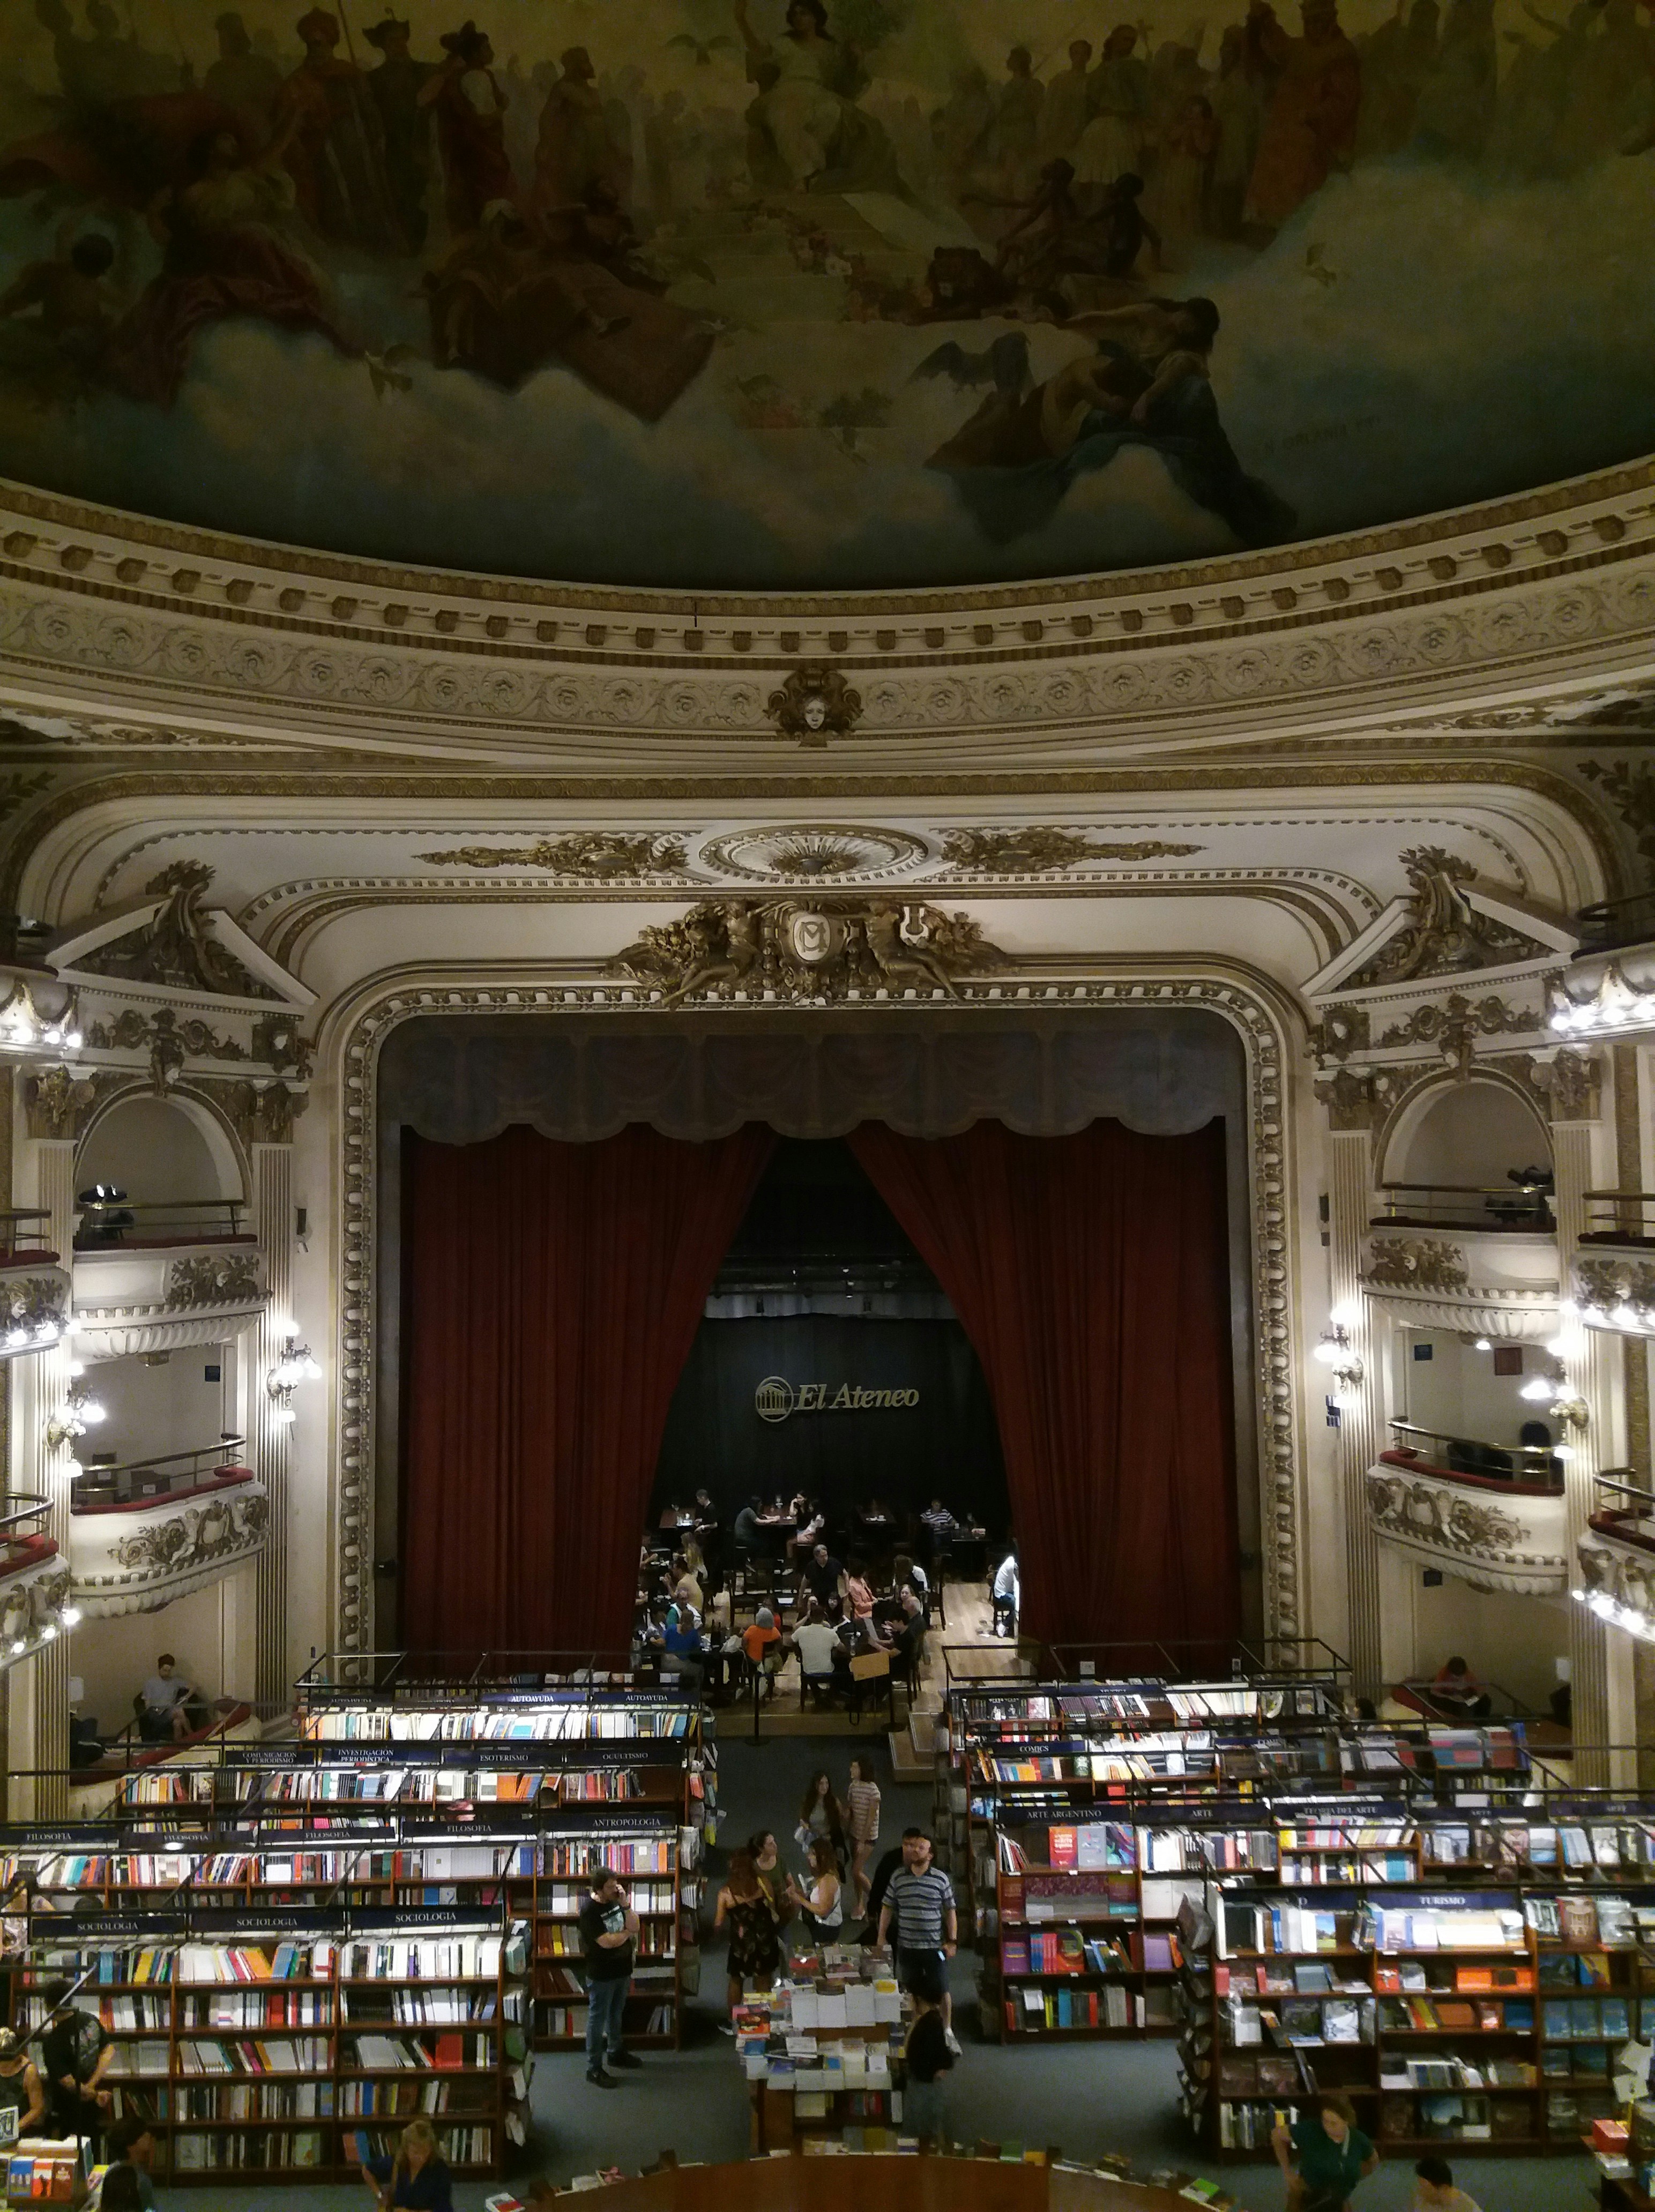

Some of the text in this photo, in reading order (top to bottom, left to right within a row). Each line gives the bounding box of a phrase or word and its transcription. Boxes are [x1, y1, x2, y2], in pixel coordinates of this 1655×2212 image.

[794, 1383, 920, 1410] El Ateneo
[1027, 1810, 1102, 1819] ARTE ARGENTINO
[1192, 1809, 1213, 1817] ARTE
[593, 1818, 661, 1826] ANTROPOLOGIA
[27, 1833, 72, 1841] FILOSOFIA
[1419, 1896, 1466, 1904] TURISMO
[395, 1912, 456, 1922] SOCIOLOGIA
[236, 1918, 298, 1926] SOCIOLOGIA
[77, 1922, 139, 1931] SOCIOLOGIA
